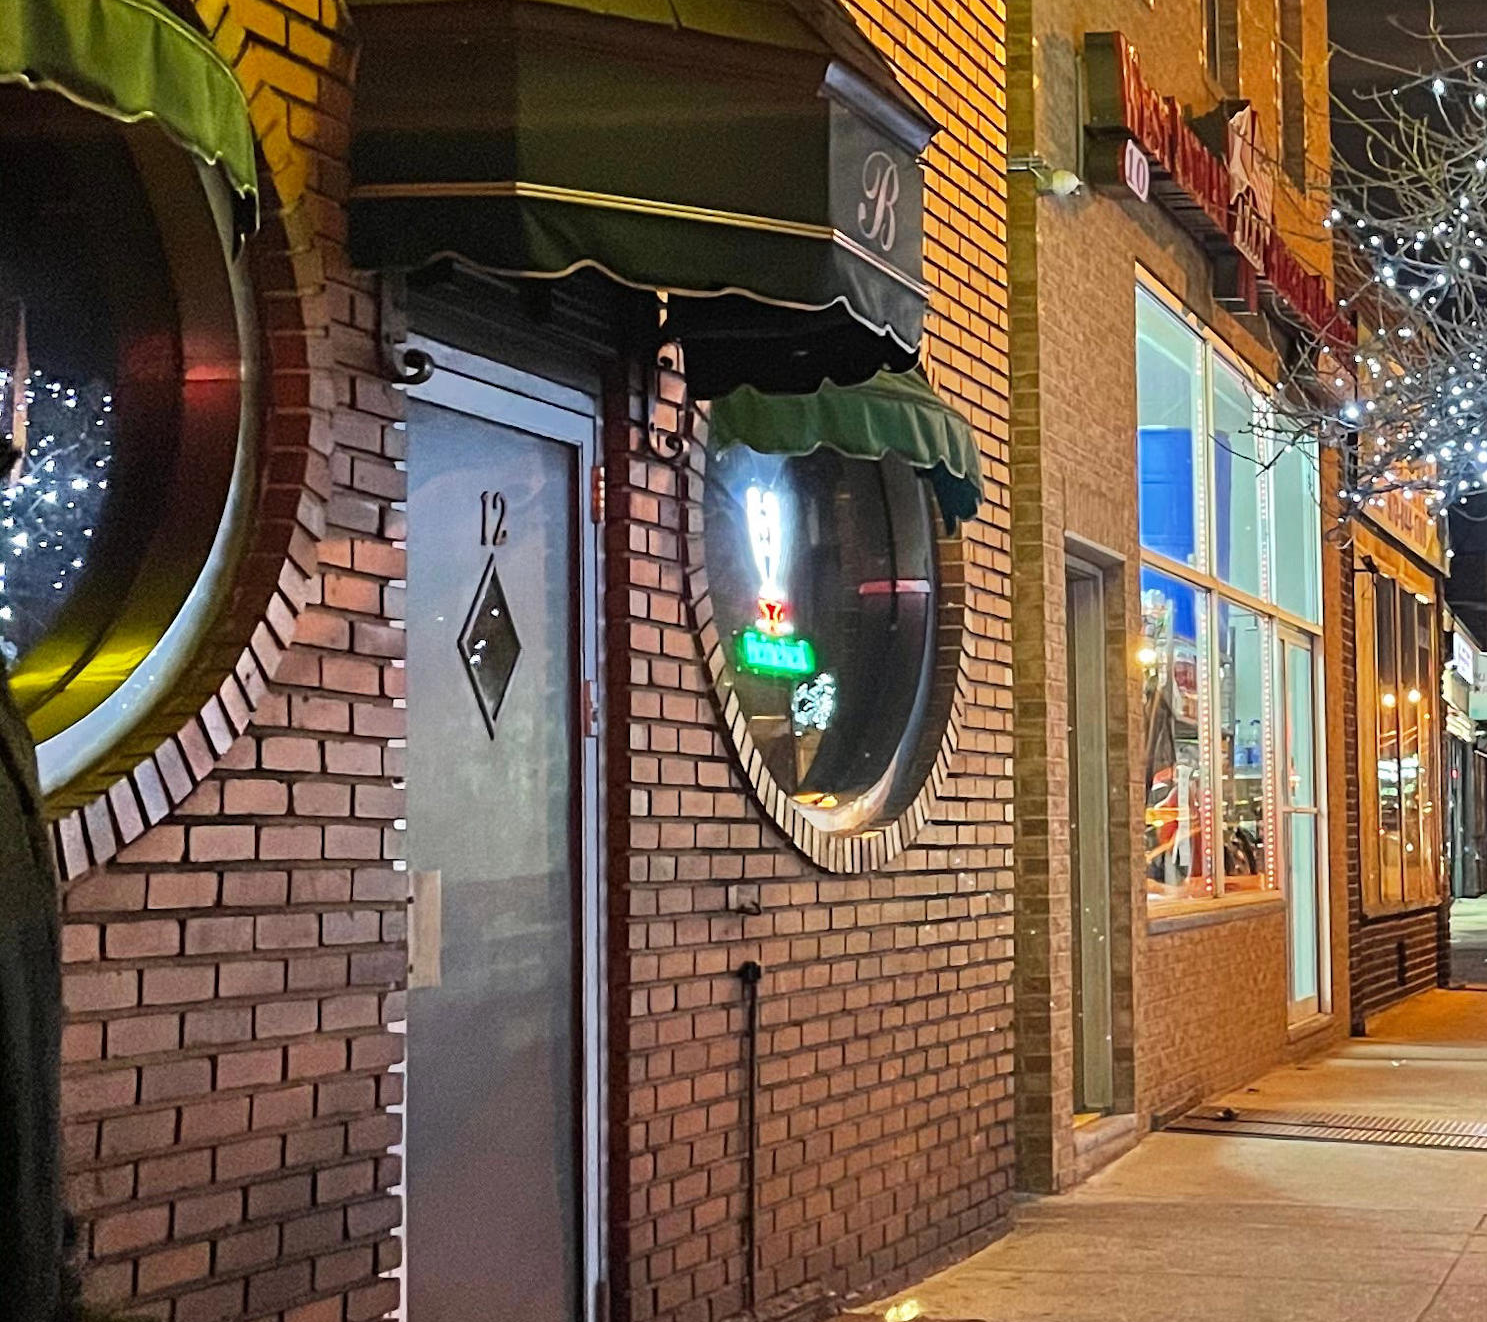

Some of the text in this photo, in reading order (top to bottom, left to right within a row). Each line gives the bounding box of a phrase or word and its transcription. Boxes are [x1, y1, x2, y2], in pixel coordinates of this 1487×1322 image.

[1128, 148, 1146, 195] 10
[858, 151, 900, 252] B
[479, 490, 507, 547] 12
